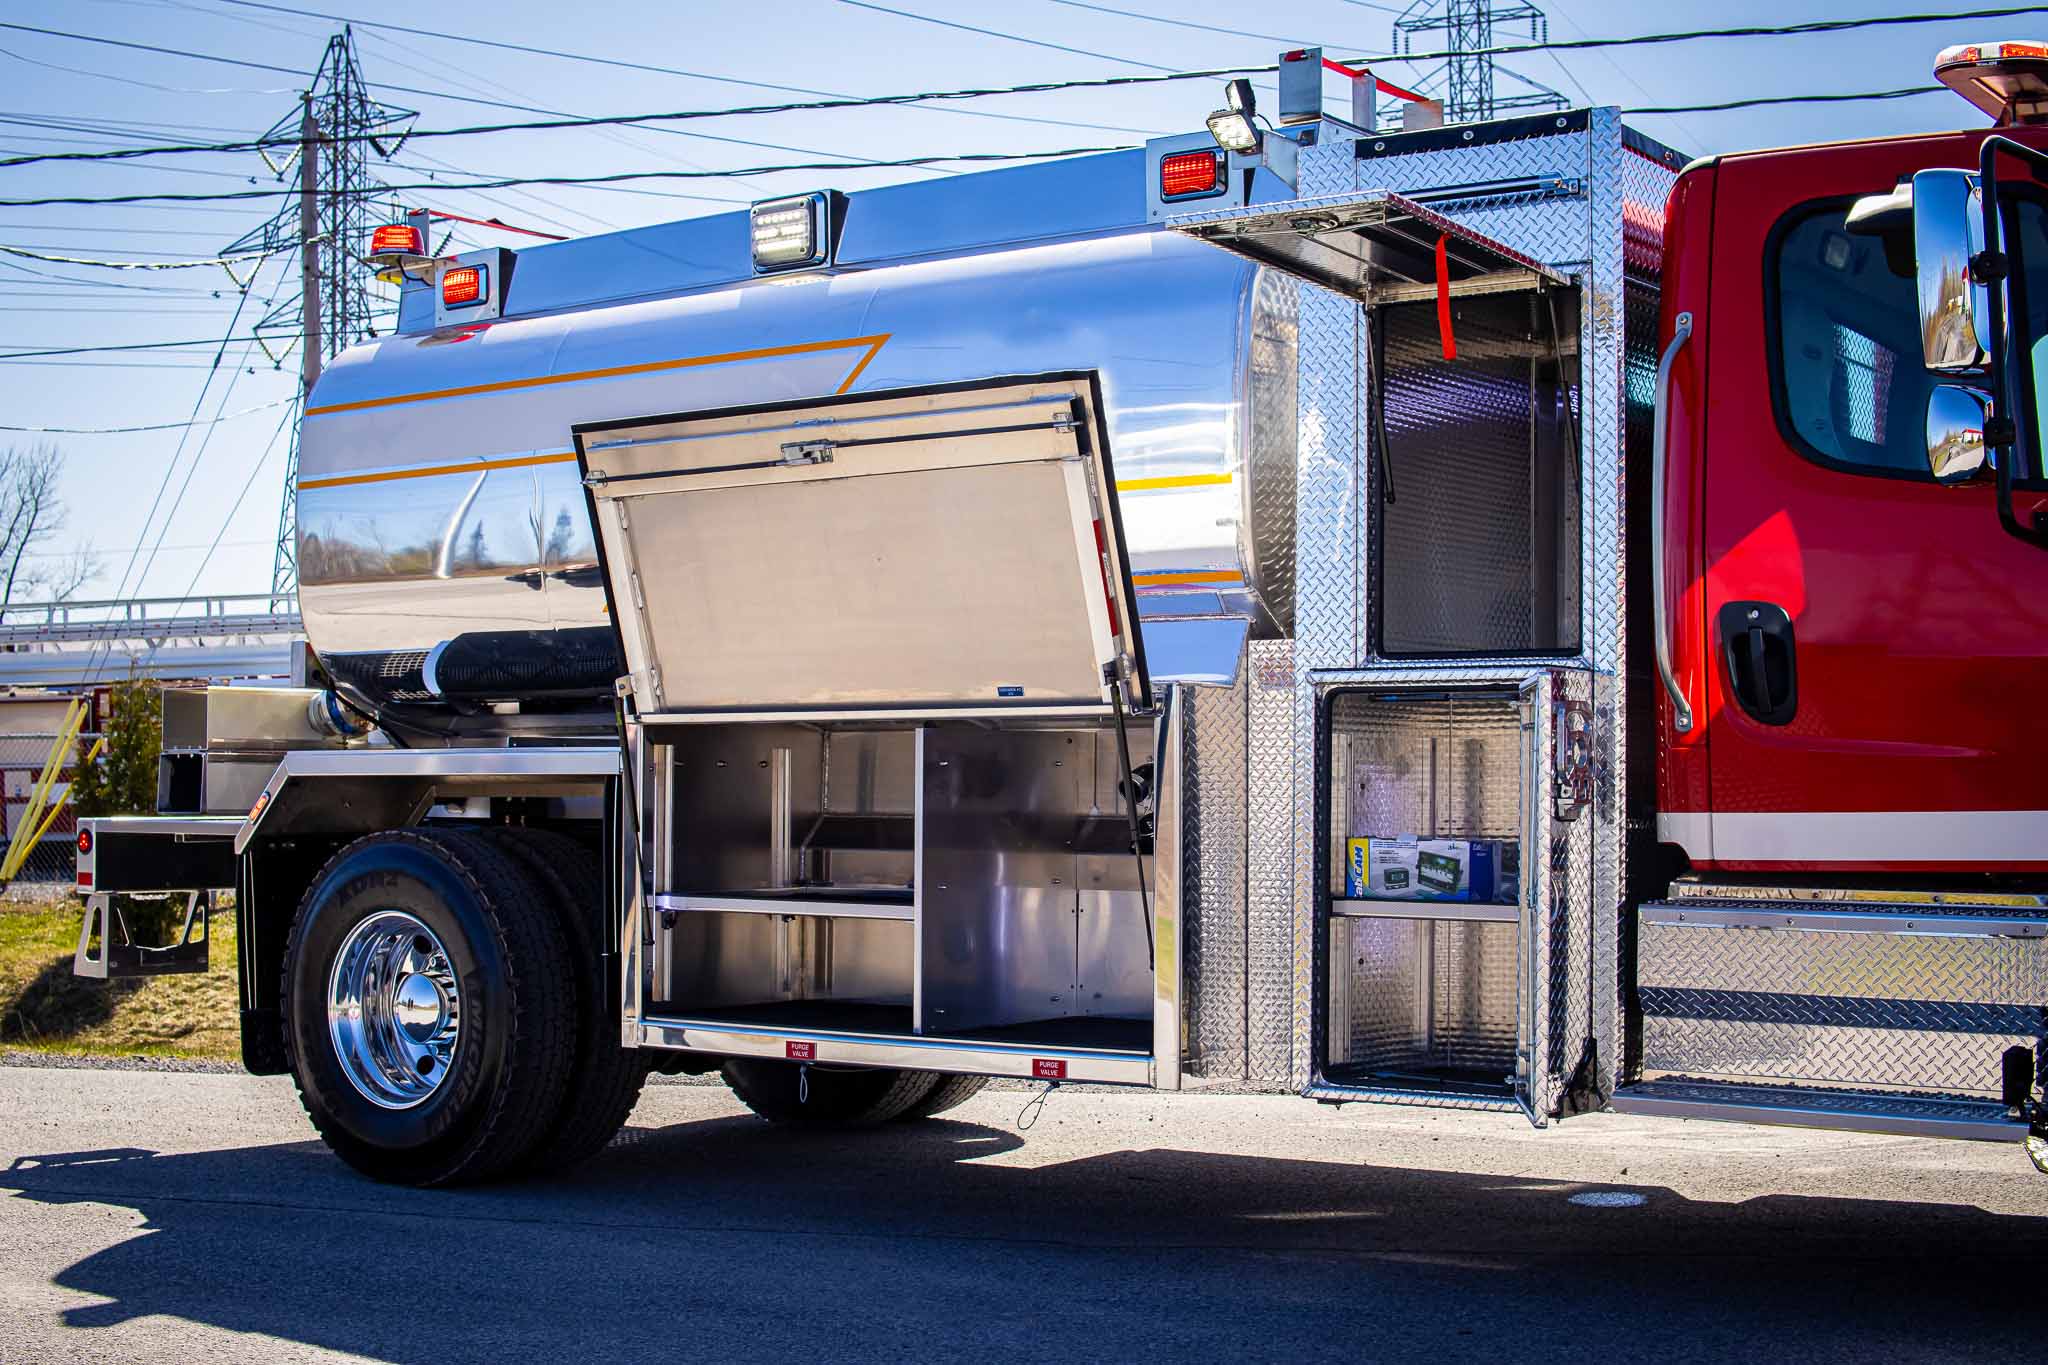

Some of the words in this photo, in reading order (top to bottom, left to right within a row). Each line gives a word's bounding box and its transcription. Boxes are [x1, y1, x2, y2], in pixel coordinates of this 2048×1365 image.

[1353, 845, 1364, 897] abCAM
[791, 1042, 809, 1051] PURGE
[792, 1050, 809, 1058] VALVE
[1039, 1061, 1059, 1069] PURGE
[1040, 1069, 1059, 1077] VALVE
